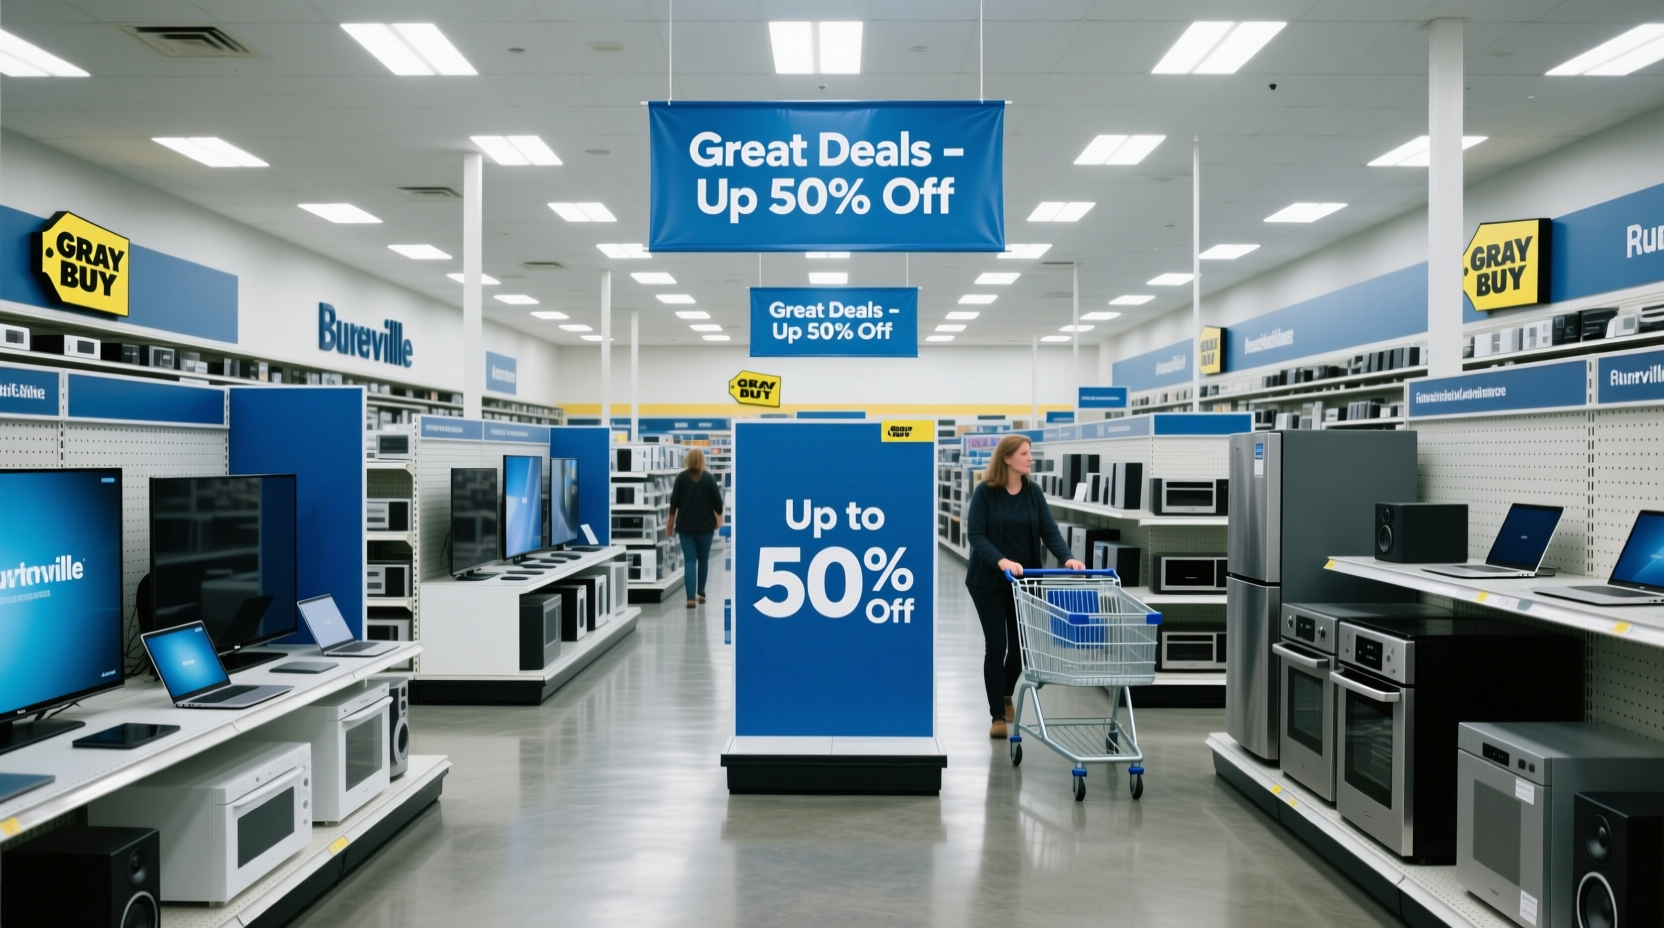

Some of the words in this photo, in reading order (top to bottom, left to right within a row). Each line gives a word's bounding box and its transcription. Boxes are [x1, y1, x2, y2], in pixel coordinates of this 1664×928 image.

[690, 131, 807, 167] Great
[818, 131, 932, 167] Deals
[697, 178, 758, 224] Up
[768, 177, 871, 215] 50%
[882, 176, 955, 215] Off
[56, 231, 125, 273] GRAY
[1470, 235, 1533, 272] GRAY
[60, 259, 118, 297] BUY
[1476, 264, 1527, 297] BUY
[769, 301, 825, 319] Great
[828, 301, 883, 319] Deals
[772, 322, 803, 344] Up
[806, 321, 854, 340] 50%
[857, 321, 893, 340] Off
[785, 498, 838, 539] Up
[845, 501, 886, 531] to
[752, 545, 914, 619] 50%
[865, 597, 915, 624] Off
